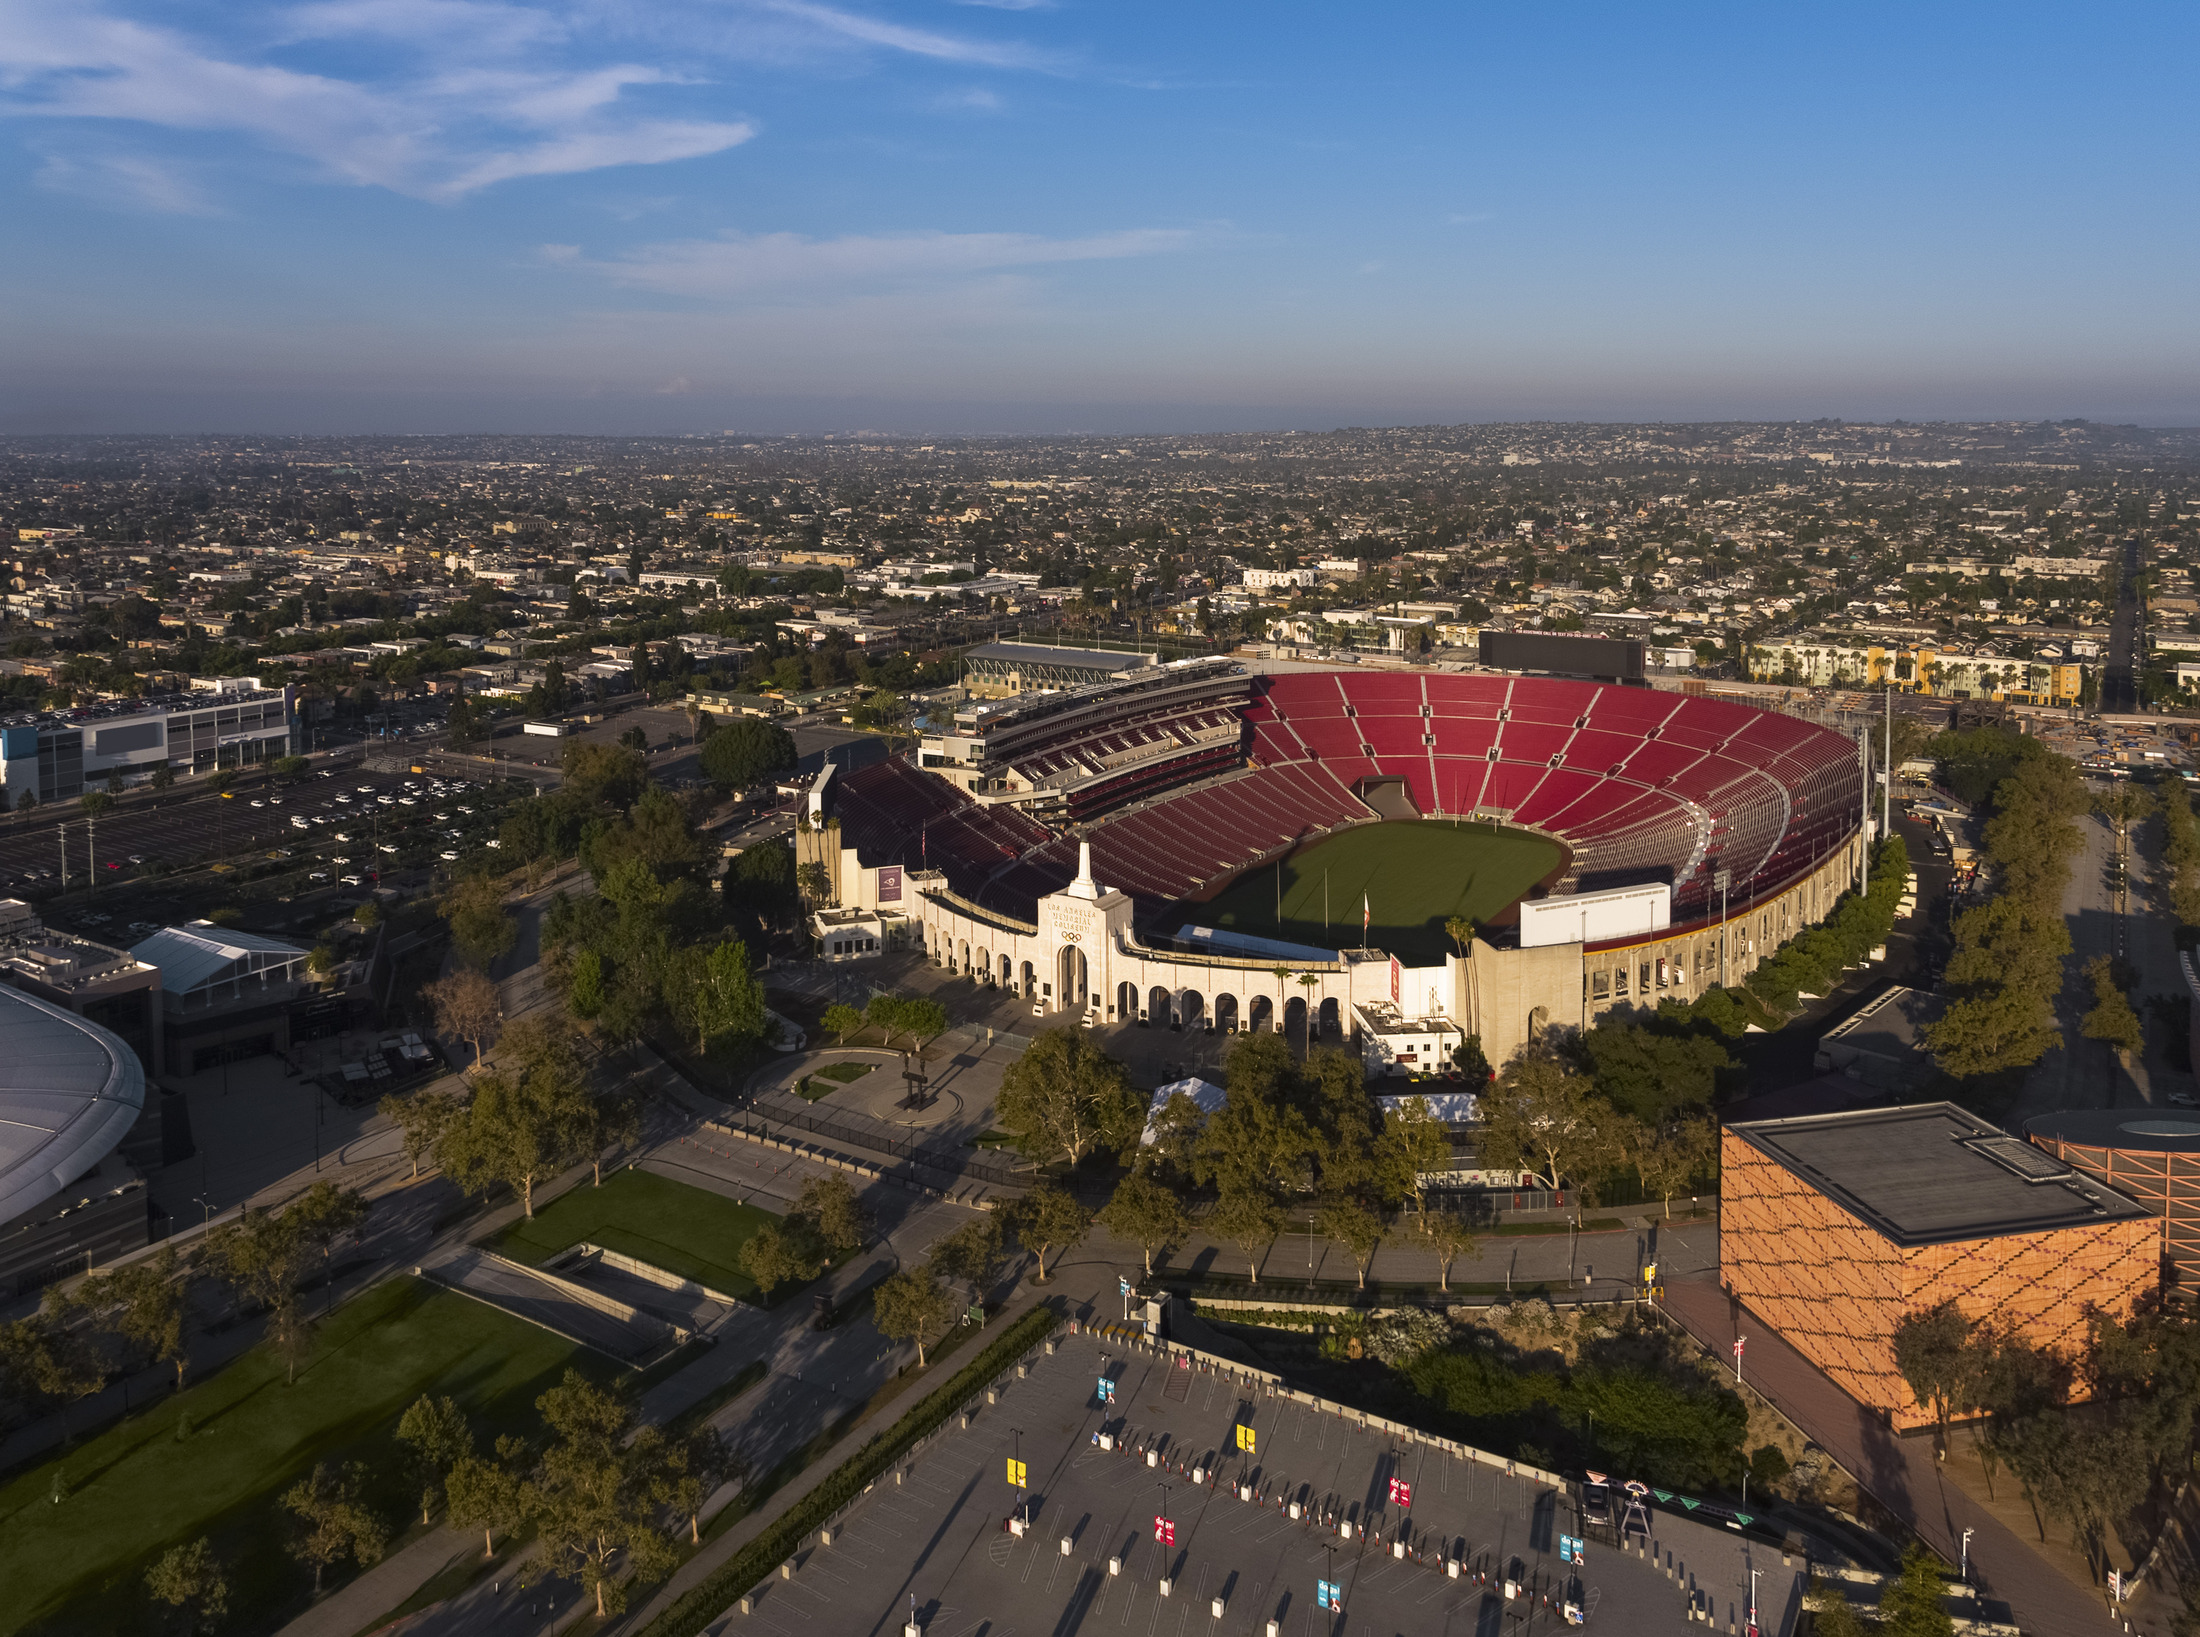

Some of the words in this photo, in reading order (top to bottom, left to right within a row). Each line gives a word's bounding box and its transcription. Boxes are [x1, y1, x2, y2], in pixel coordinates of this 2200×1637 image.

[1063, 906, 1096, 918] ANGELES
[1052, 912, 1091, 926] MEMORIAL
[1054, 920, 1090, 934] COLISEUM
[1390, 1477, 1410, 1490] dogs!
[1155, 1516, 1175, 1530] dogs!
[1561, 1535, 1583, 1548] dogs!
[1318, 1581, 1340, 1594] dogs!
